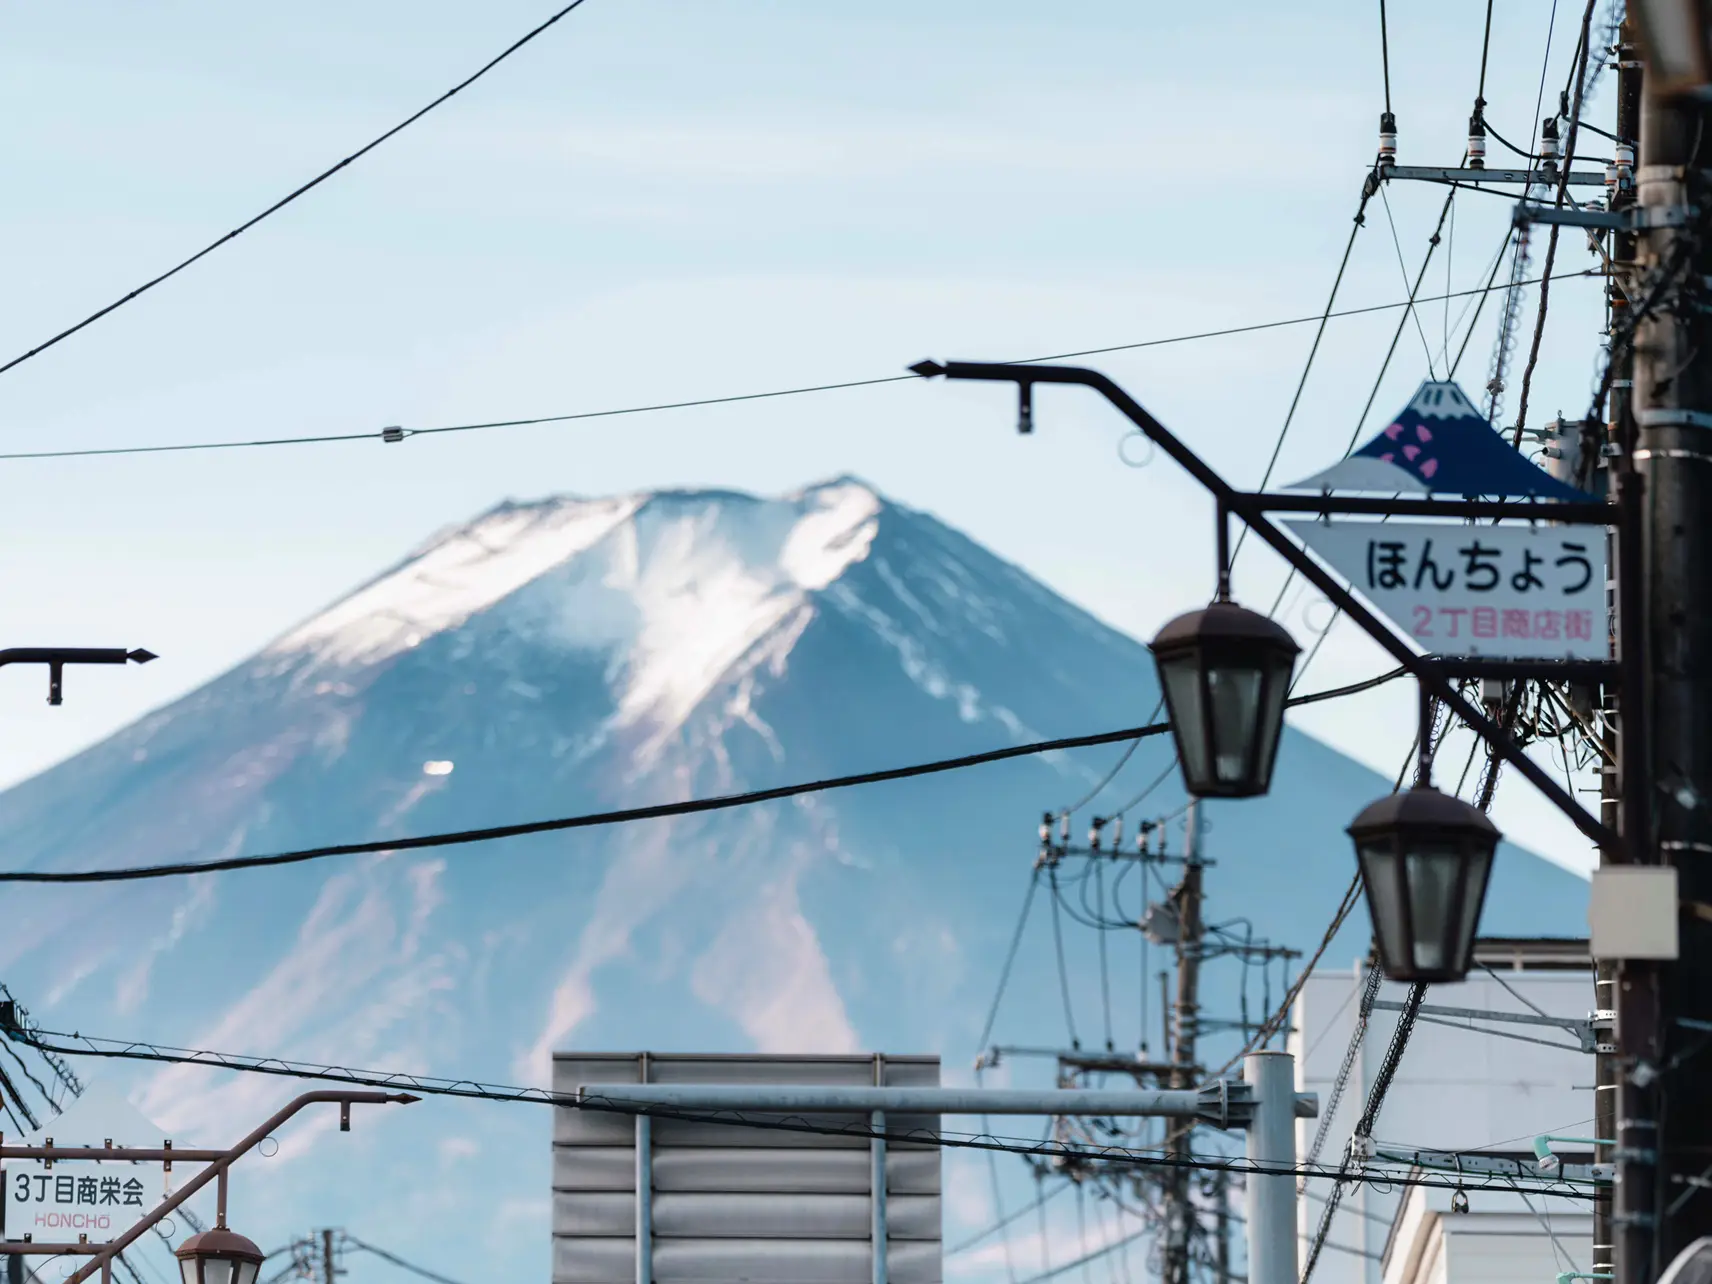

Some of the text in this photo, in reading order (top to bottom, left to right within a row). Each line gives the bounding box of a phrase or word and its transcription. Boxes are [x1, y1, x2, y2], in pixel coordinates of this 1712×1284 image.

[1367, 538, 1593, 595] ほんちょう
[14, 1173, 144, 1207] 3丁目商栄会
